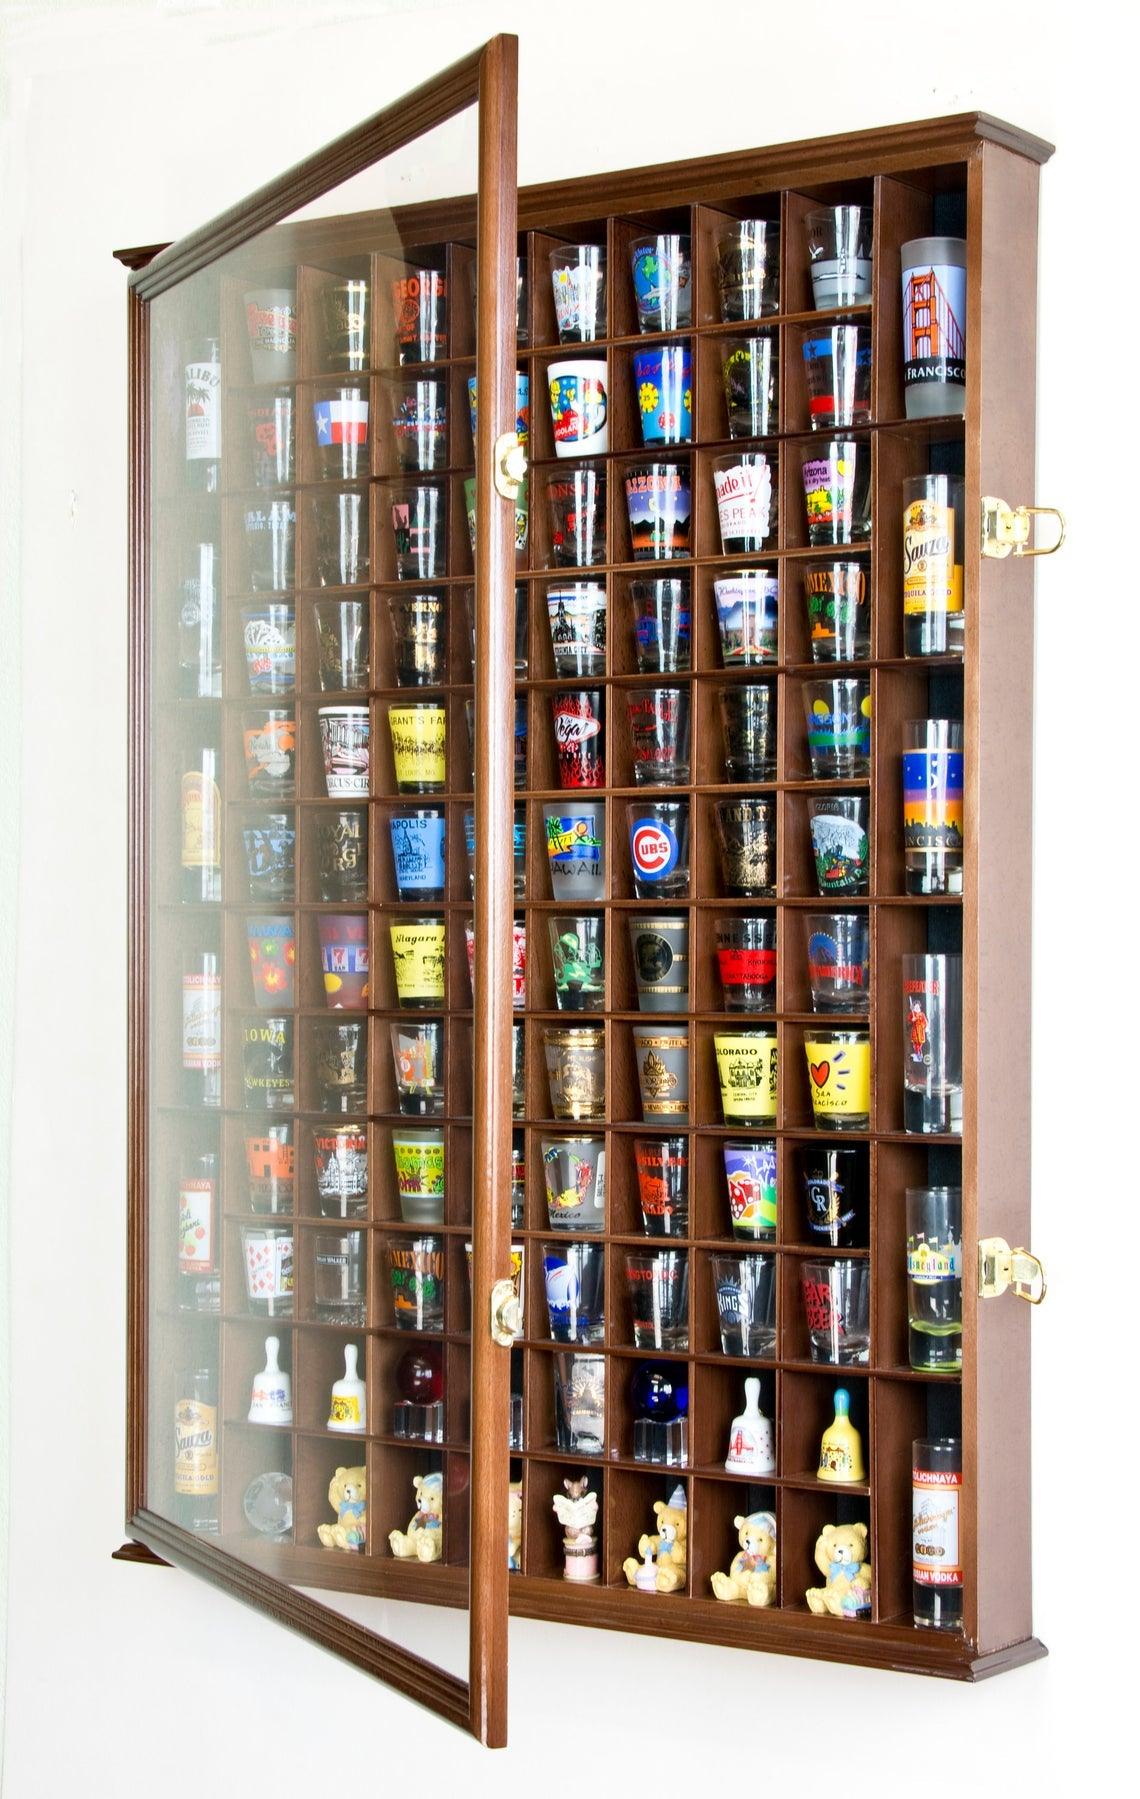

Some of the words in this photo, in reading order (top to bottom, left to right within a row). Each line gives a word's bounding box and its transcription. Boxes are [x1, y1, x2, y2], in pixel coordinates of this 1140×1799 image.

[904, 534, 949, 575] Sauza
[396, 933, 438, 946] Niagara
[930, 1570, 959, 1583] VODKA
